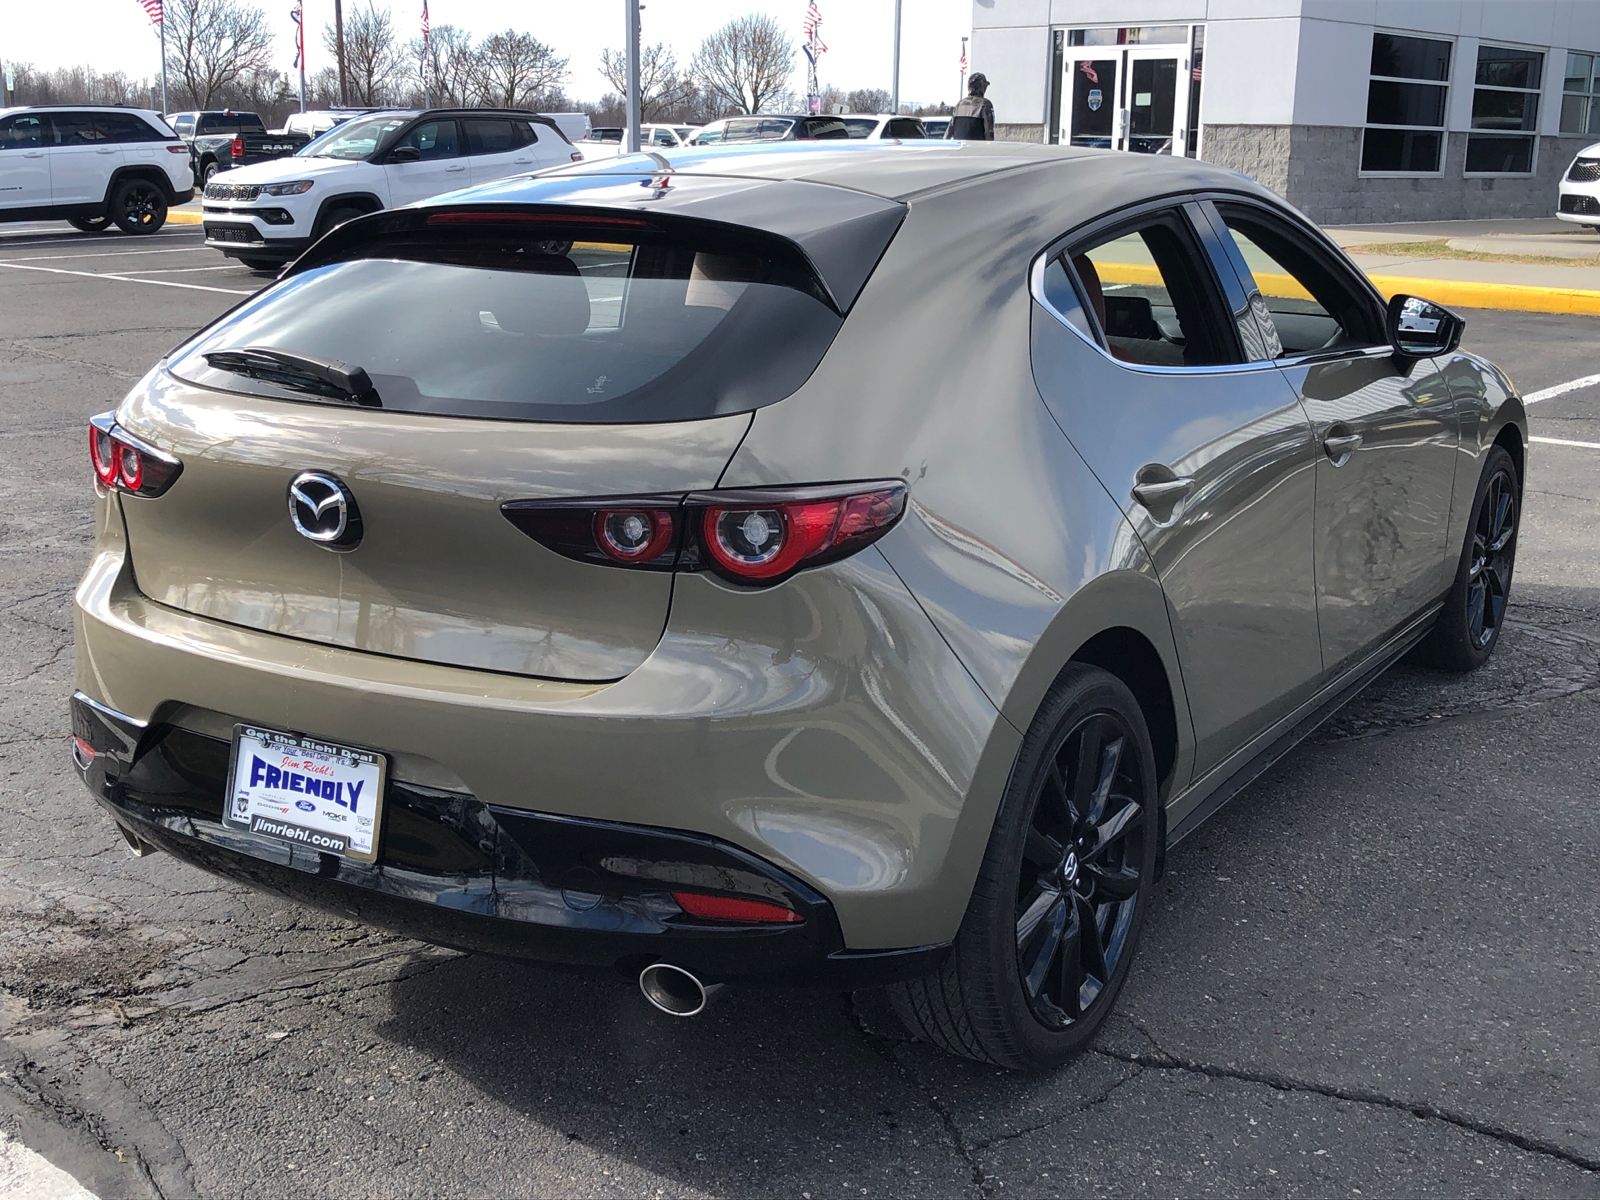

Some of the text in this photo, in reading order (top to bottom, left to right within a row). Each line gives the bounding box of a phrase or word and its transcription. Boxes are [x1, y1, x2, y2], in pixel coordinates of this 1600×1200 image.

[246, 728, 373, 763] Get the Riehl Deal
[271, 743, 283, 751] For
[282, 745, 298, 757] Your
[280, 756, 335, 777] Jim Riehl's
[249, 753, 365, 814] FRIENDLY
[298, 800, 313, 812] Ford
[322, 810, 348, 822] MOKE
[252, 818, 344, 851] jimriehl.com
